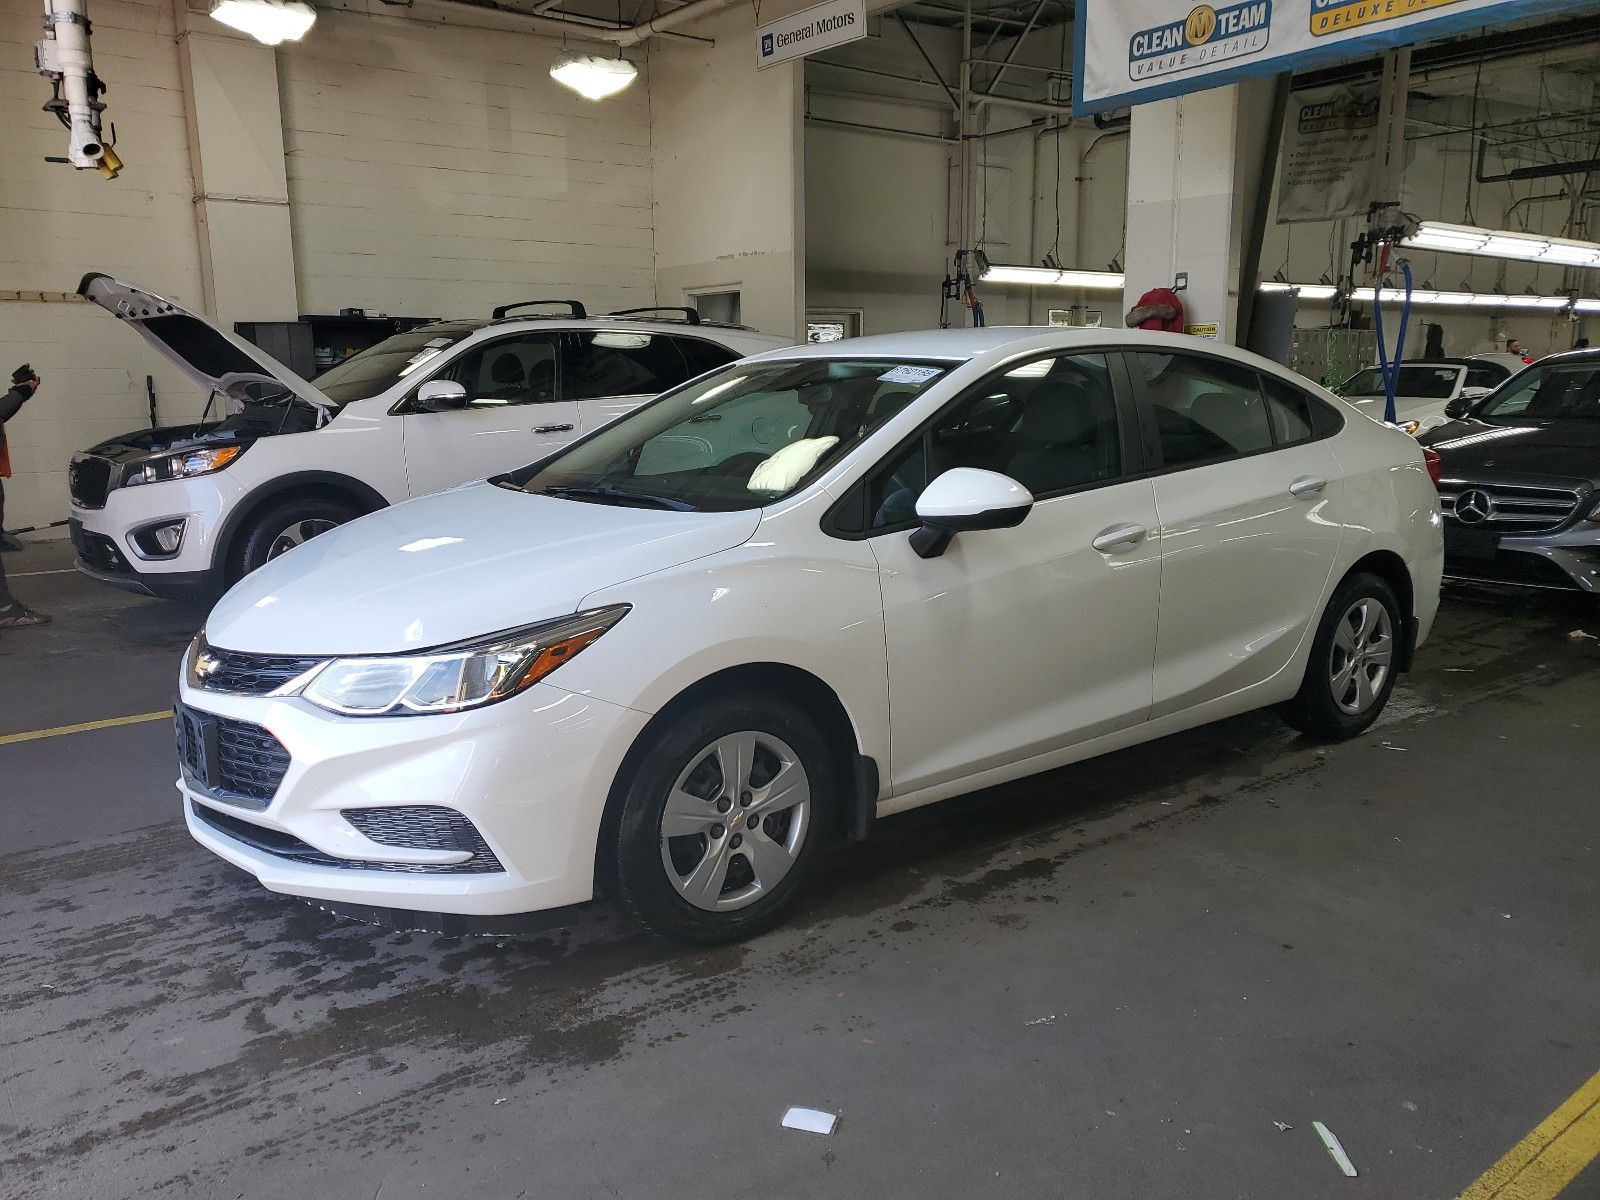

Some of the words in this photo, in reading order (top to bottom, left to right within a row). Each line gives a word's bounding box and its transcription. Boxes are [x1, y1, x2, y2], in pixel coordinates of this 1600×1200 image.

[777, 22, 815, 48] General
[816, 12, 855, 36] Motors
[1132, 24, 1185, 57] CLEAN
[1217, 1, 1267, 36] TEAM
[1319, 0, 1395, 29] DELUXE
[1136, 53, 1188, 75] VALUE
[1199, 35, 1259, 60] DETAIL
